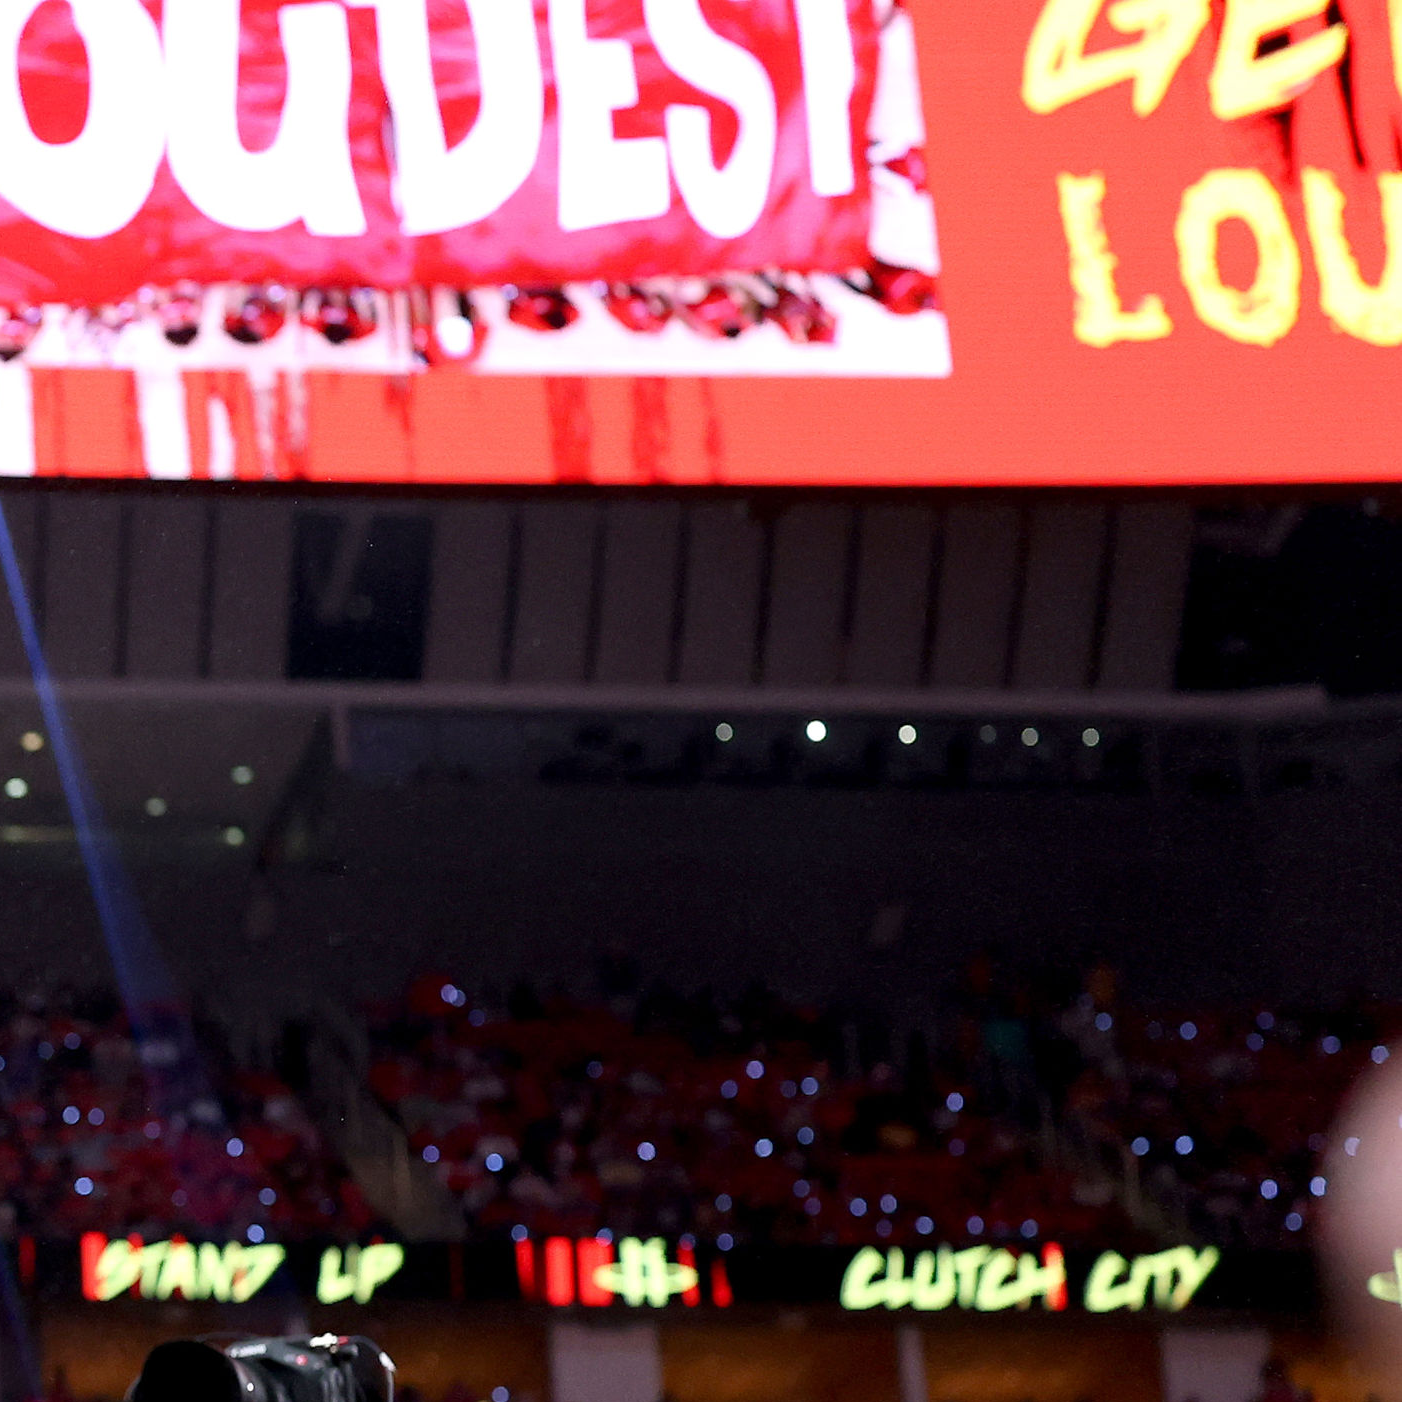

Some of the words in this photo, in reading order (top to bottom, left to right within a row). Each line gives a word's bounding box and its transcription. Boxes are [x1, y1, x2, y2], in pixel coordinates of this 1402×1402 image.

[1022, 0, 1402, 120] GE
[95, 1239, 286, 1304] STAND
[316, 1243, 404, 1304] UP
[840, 1245, 1066, 1312] CLUTCH
[1084, 1245, 1219, 1313] CITY
